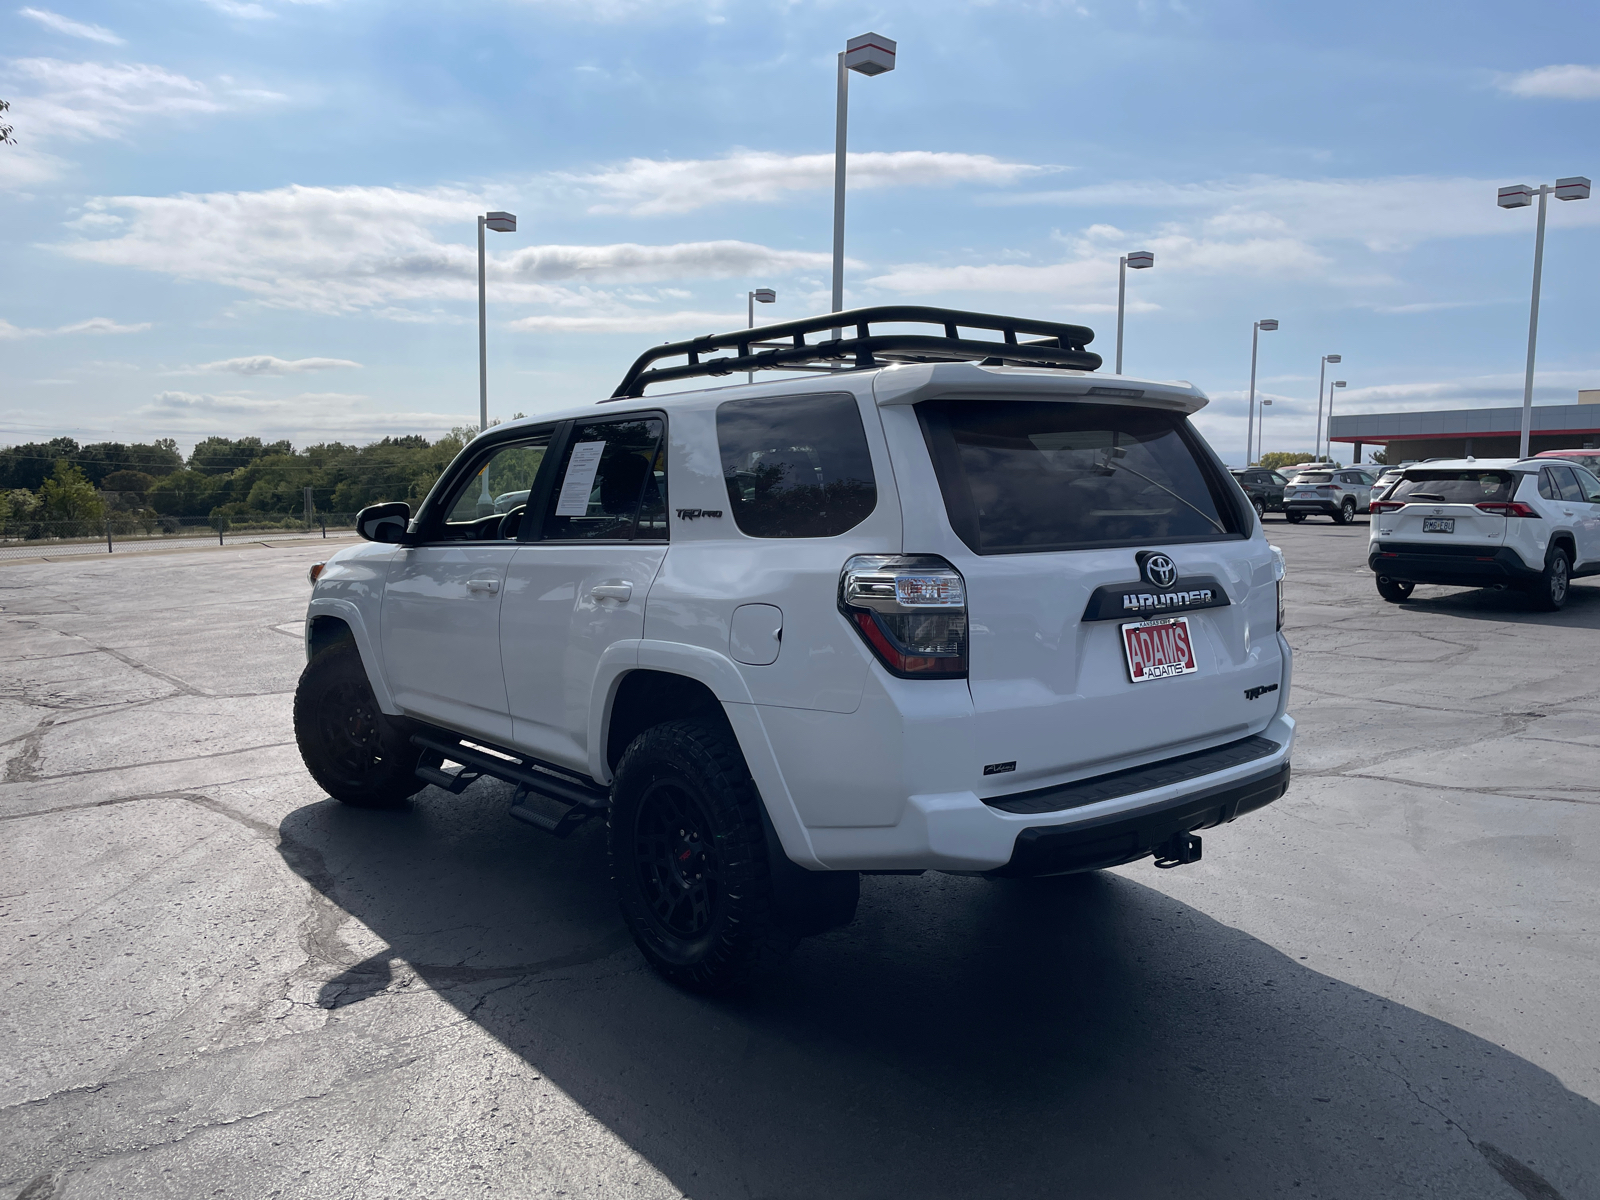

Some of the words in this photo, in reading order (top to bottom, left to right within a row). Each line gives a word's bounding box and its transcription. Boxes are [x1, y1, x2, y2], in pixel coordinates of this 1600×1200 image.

[675, 508, 702, 521] TRD
[702, 510, 723, 518] PRO
[1123, 589, 1212, 611] 4RUNNER
[1130, 627, 1189, 672] ADAMS
[1147, 663, 1184, 678] ADAMS
